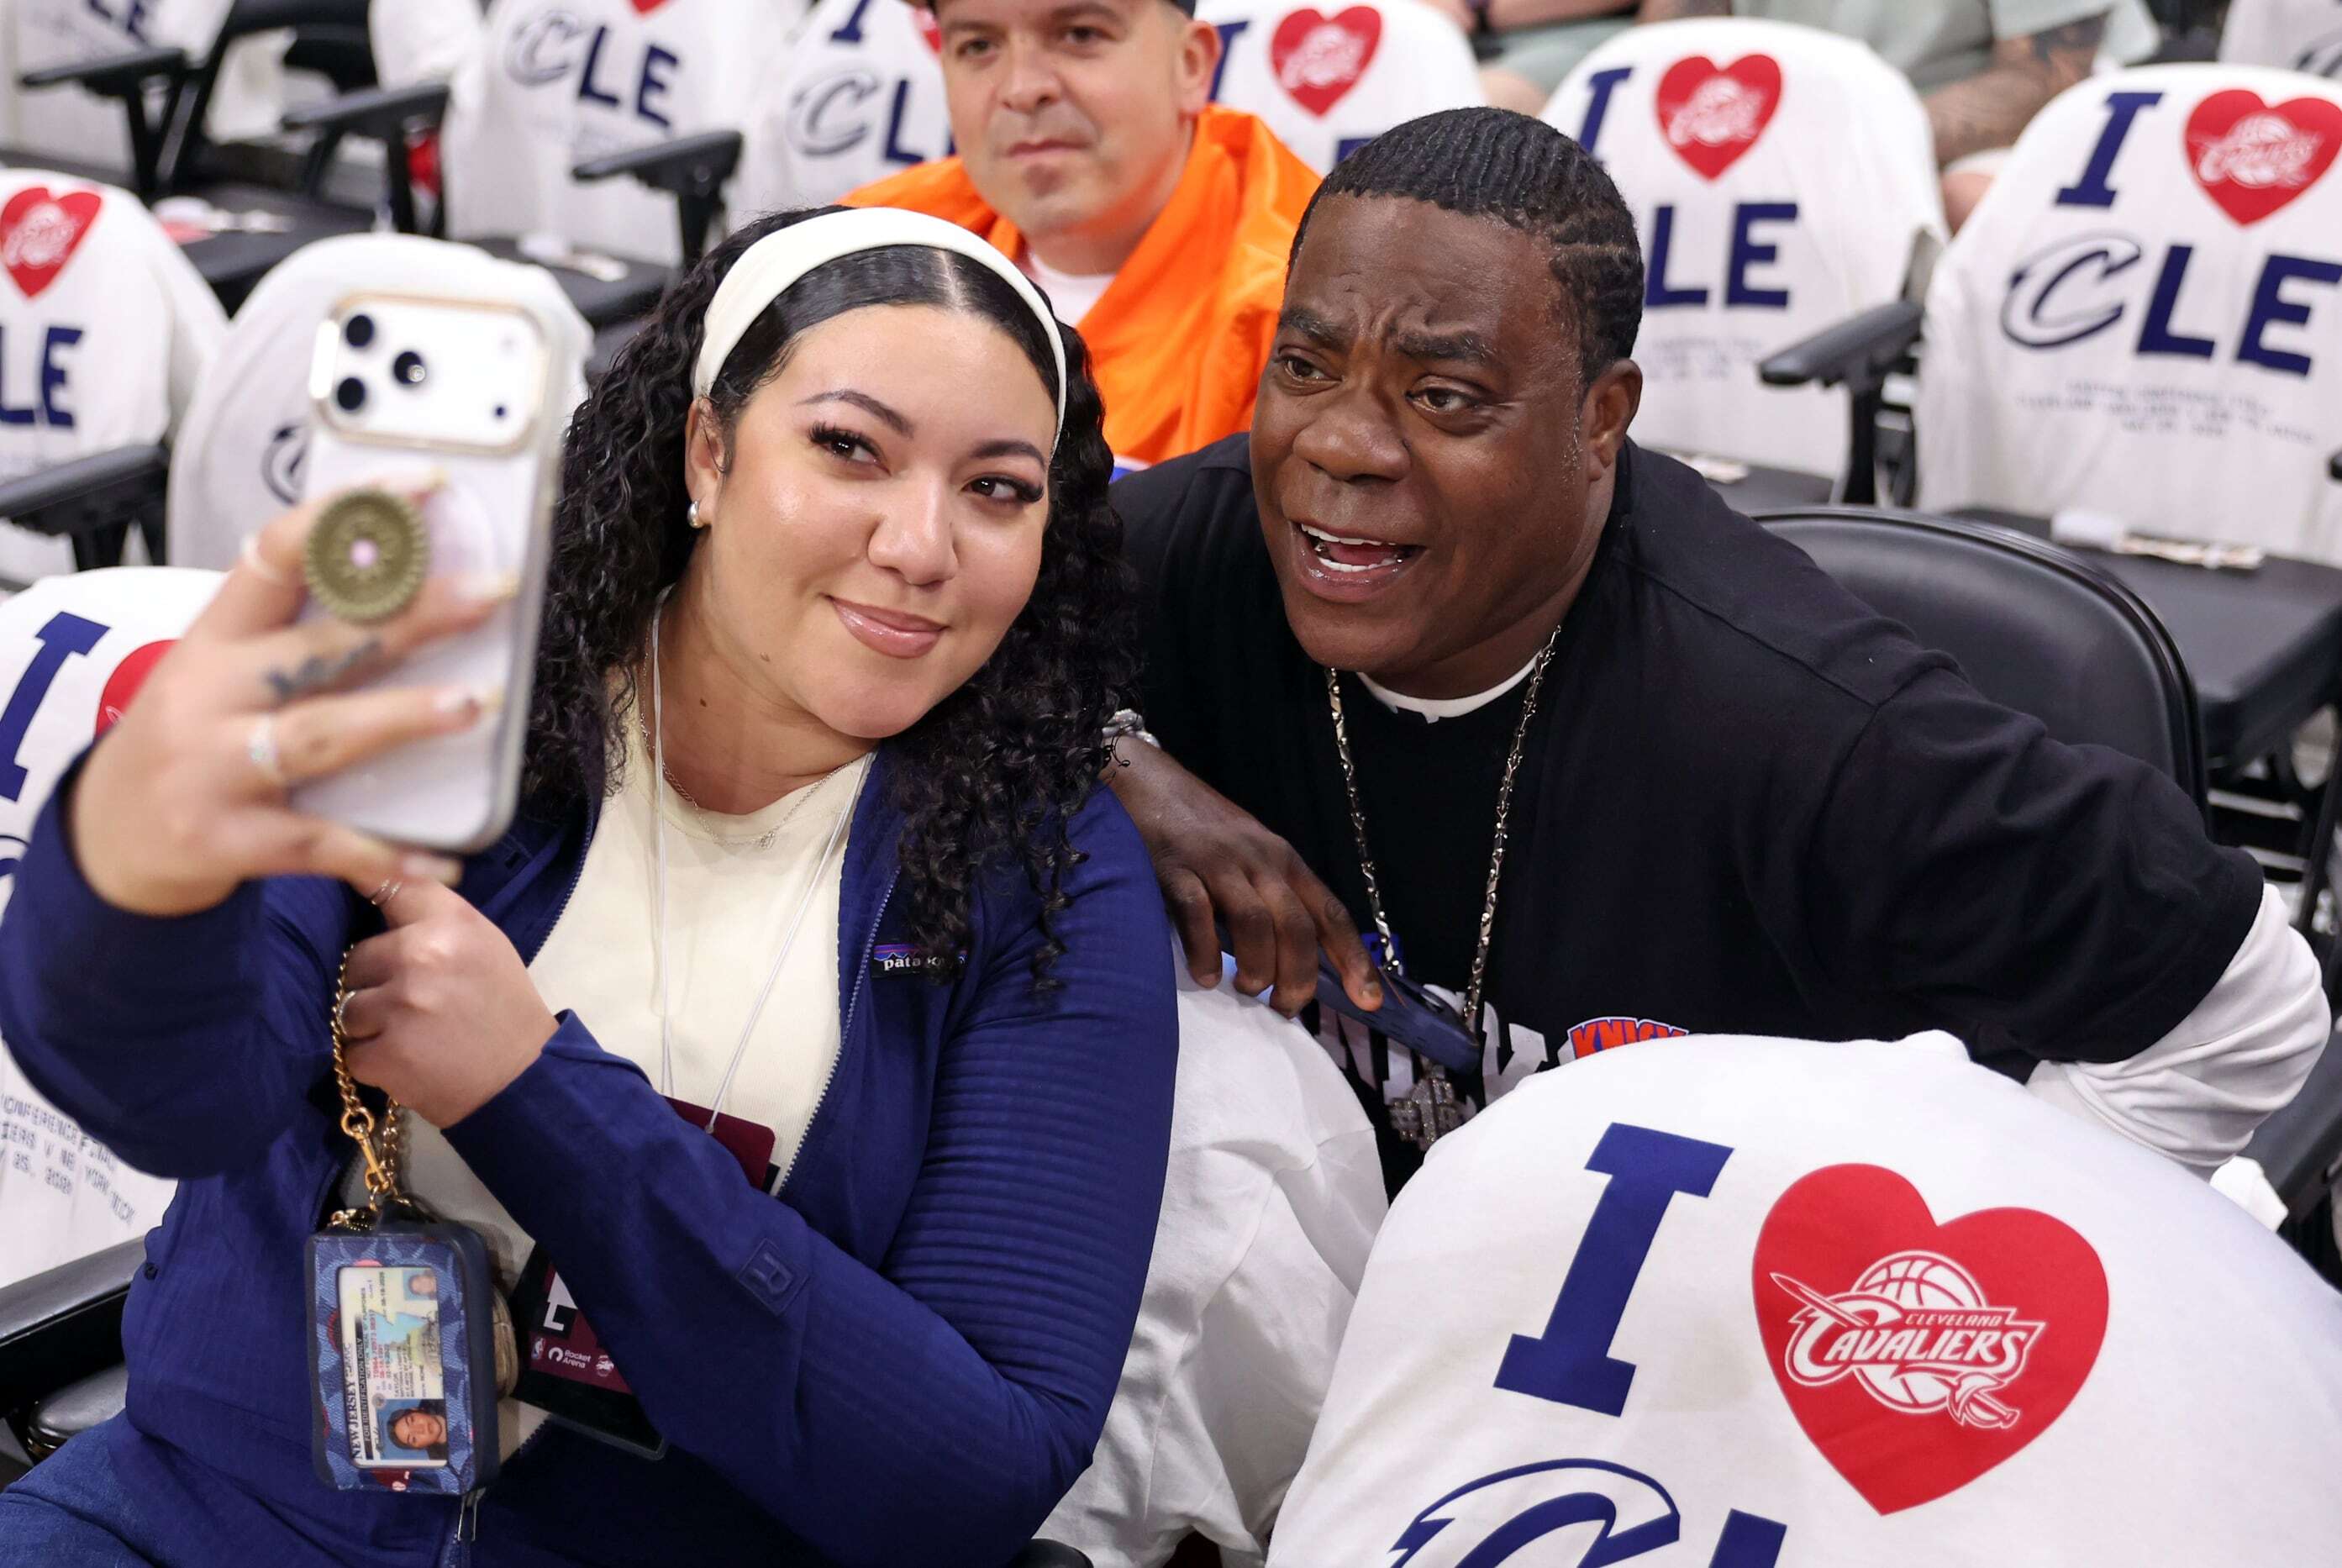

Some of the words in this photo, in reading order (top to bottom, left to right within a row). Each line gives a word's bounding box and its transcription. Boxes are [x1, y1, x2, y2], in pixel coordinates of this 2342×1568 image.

[786, 69, 956, 163] CL
[2055, 92, 2163, 208] I
[1644, 203, 1799, 308] LE
[2000, 229, 2342, 376] CLE
[0, 327, 83, 427] LE
[0, 1094, 78, 1144] ONFERENCE
[1493, 1122, 1734, 1418] I
[565, 1350, 592, 1362] Rocket
[1792, 1298, 2029, 1378] CAVALIERS
[1905, 1313, 2003, 1328] CLEVELAND
[358, 1360, 369, 1423] IDENTIFICATION
[562, 1357, 587, 1369] Arena
[345, 1381, 359, 1428] JERSEY
[349, 1430, 363, 1460] NEW
